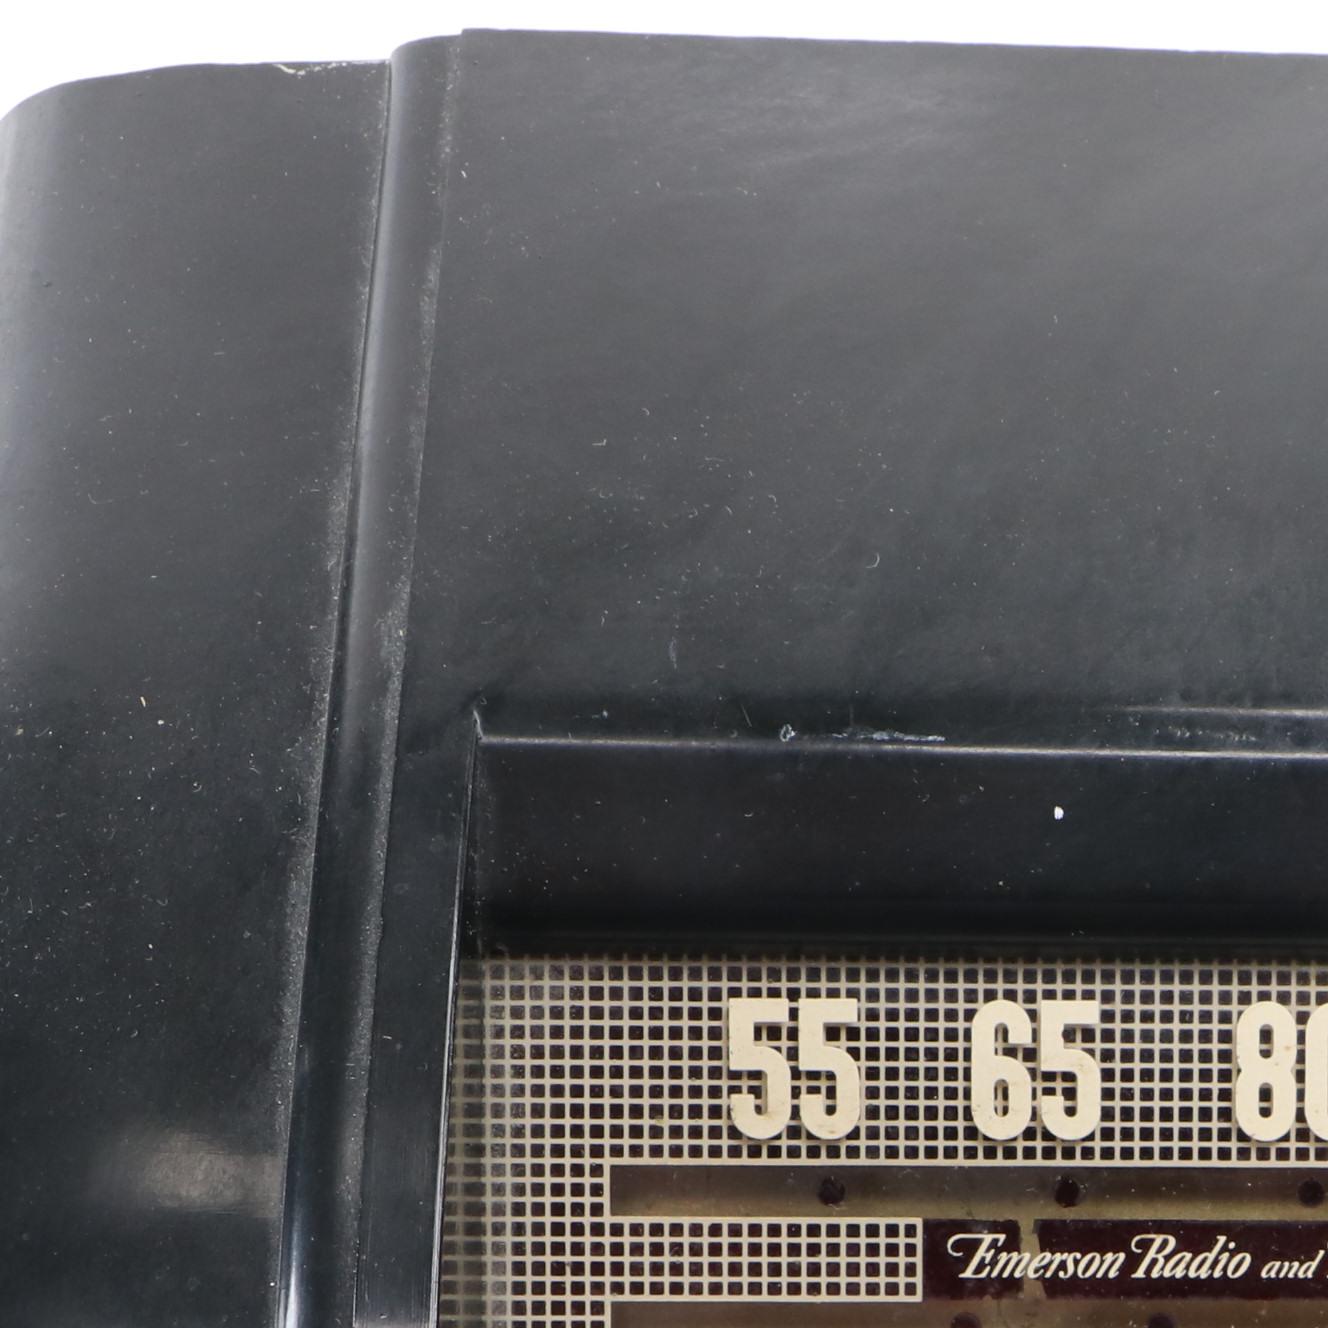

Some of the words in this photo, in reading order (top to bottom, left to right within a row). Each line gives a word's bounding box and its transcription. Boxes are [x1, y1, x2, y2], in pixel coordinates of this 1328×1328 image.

[728, 998, 861, 1140] 55
[971, 999, 1101, 1142] 65
[947, 1233, 1127, 1279] Emerson
[1131, 1234, 1252, 1280] Radio
[1260, 1250, 1325, 1280] and
